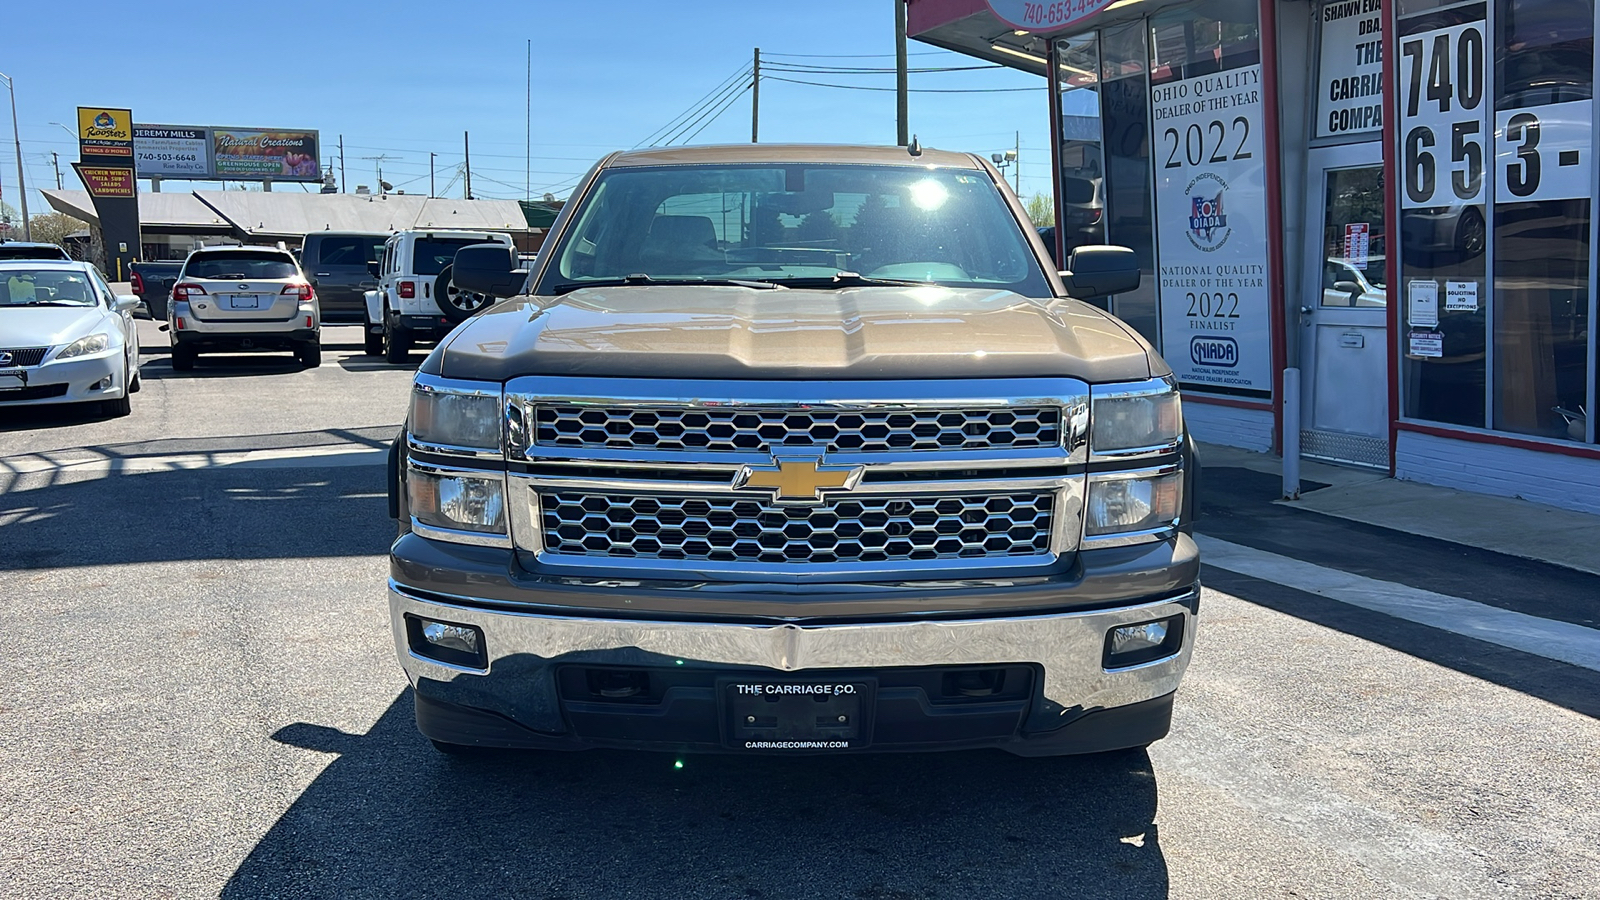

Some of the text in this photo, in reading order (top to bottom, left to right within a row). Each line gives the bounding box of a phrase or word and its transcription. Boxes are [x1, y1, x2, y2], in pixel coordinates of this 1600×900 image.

[1324, 1, 1360, 22] SHAWN
[1356, 40, 1383, 66] THE
[1403, 27, 1483, 117] 740
[1153, 84, 1187, 103] OHIO
[1194, 69, 1259, 96] QUALITY
[1155, 103, 1191, 120] DEALER
[1193, 100, 1206, 114] OF
[1208, 96, 1228, 111] THE
[1230, 90, 1259, 106] YEAR
[85, 126, 126, 138] Roosters
[219, 134, 303, 148] Natural Creations
[1164, 116, 1252, 169] 2022
[138, 153, 196, 161] 740-503-6648
[1185, 172, 1230, 196] OHIO INDEPENDENT
[1193, 216, 1220, 228] OIADA
[1162, 265, 1264, 276] NATIONAL QUALITY
[1163, 278, 1263, 288] DEALER OF THE YEAR
[1186, 292, 1240, 318] 2022
[1190, 320, 1235, 330] FINALIST
[1194, 342, 1234, 361] NIADA
[1192, 367, 1239, 376] NATIONAL INDEPENDENT
[1181, 374, 1205, 382] AUTOMOBILE
[1224, 377, 1252, 386] ASSOCIATION
[737, 684, 857, 694] THE CARRIAGE CO.
[745, 741, 848, 749] CARRIAGECOMPANY.COM
